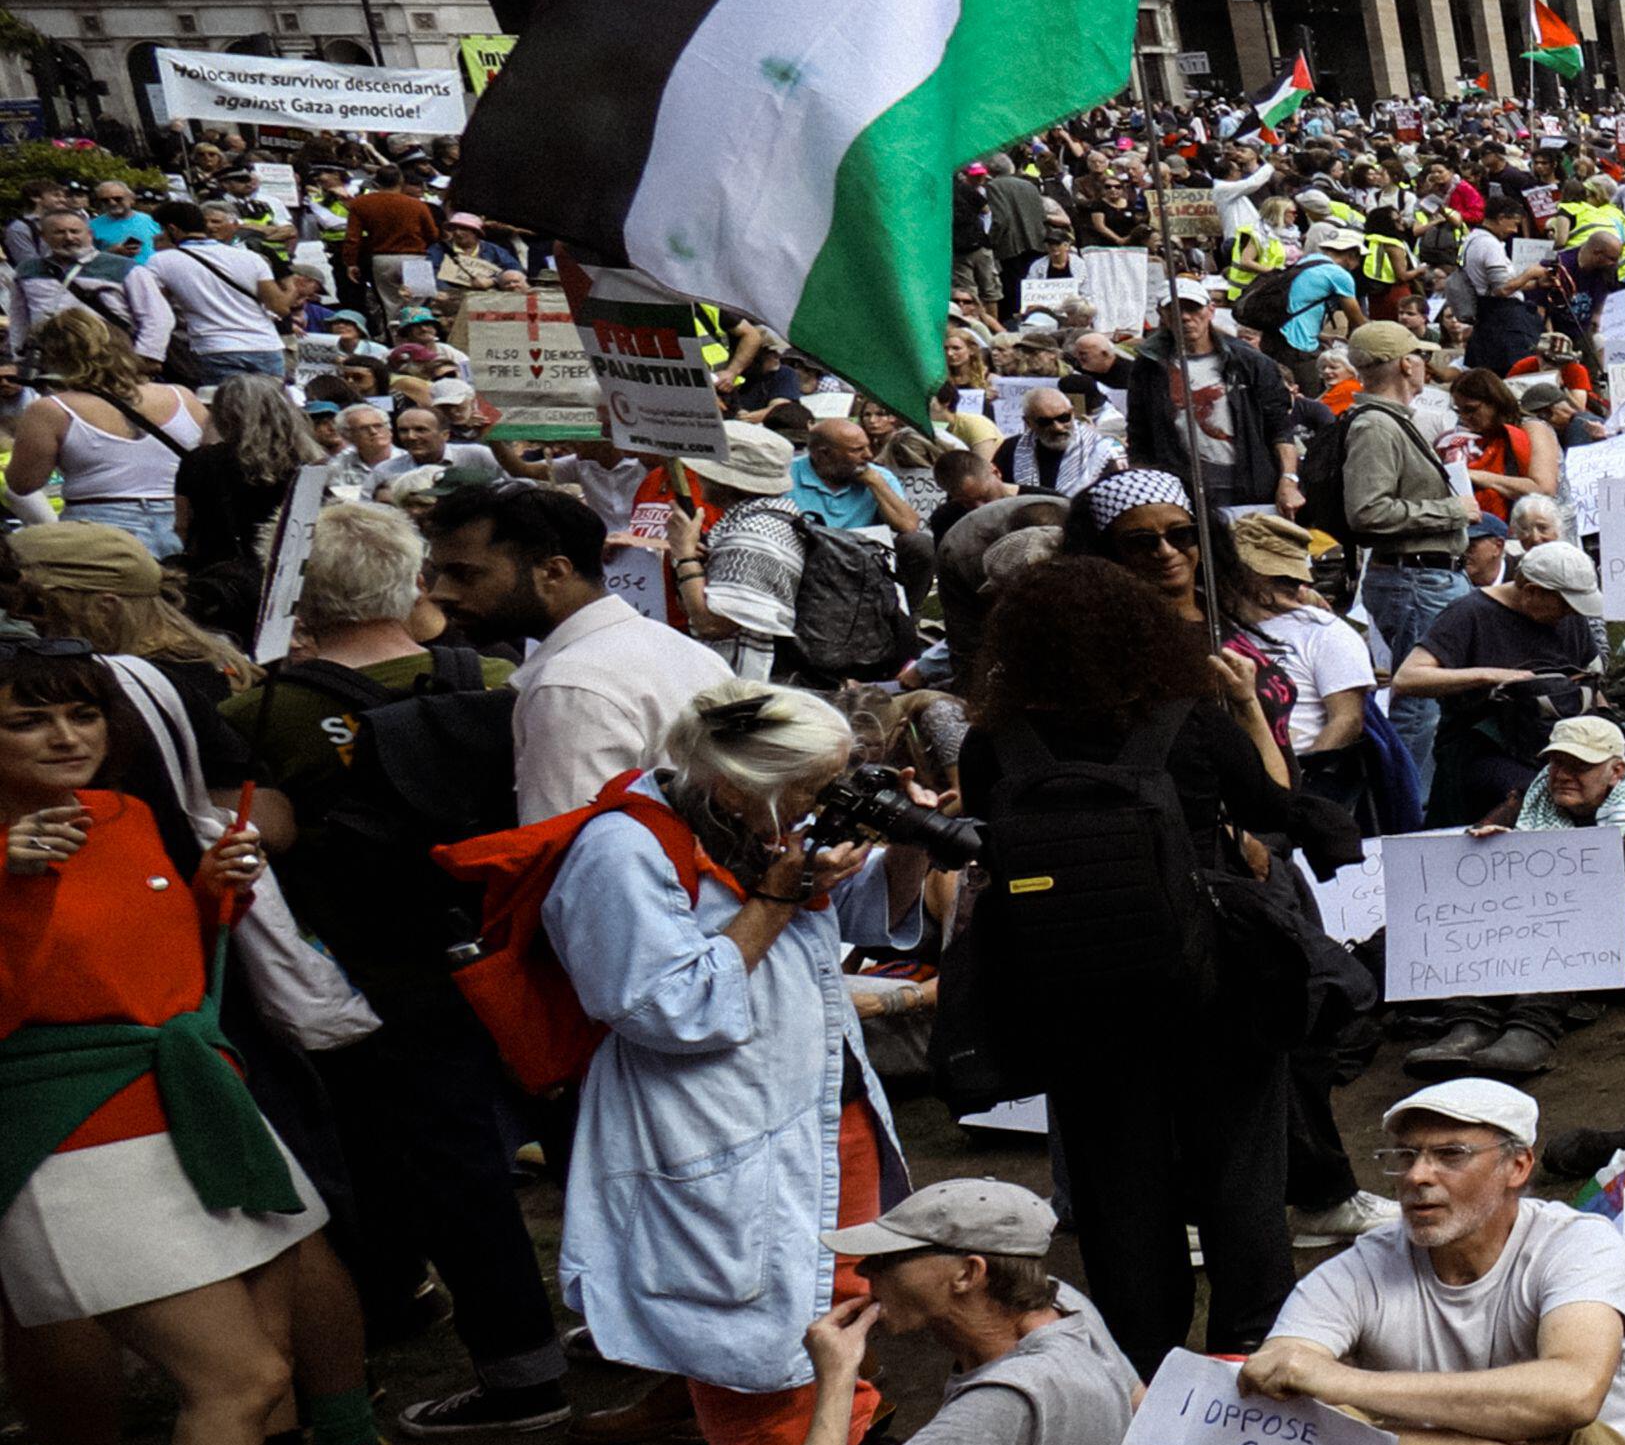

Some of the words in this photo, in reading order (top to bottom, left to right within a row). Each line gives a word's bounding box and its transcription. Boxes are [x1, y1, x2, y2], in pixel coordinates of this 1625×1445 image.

[171, 62, 266, 86] Holocaust
[270, 72, 341, 92] survivor
[345, 75, 451, 98] descendants
[214, 93, 286, 118] against
[290, 97, 335, 115] Gaza
[339, 99, 422, 123] genocide!
[1455, 847, 1600, 887] OPPOSE
[1415, 890, 1577, 932] GENOCIDE
[1446, 920, 1570, 953] SUPPORT
[1411, 958, 1530, 991] PALESTINE
[1542, 943, 1622, 971] ACTION
[1204, 1400, 1318, 1443] OPPOSE
